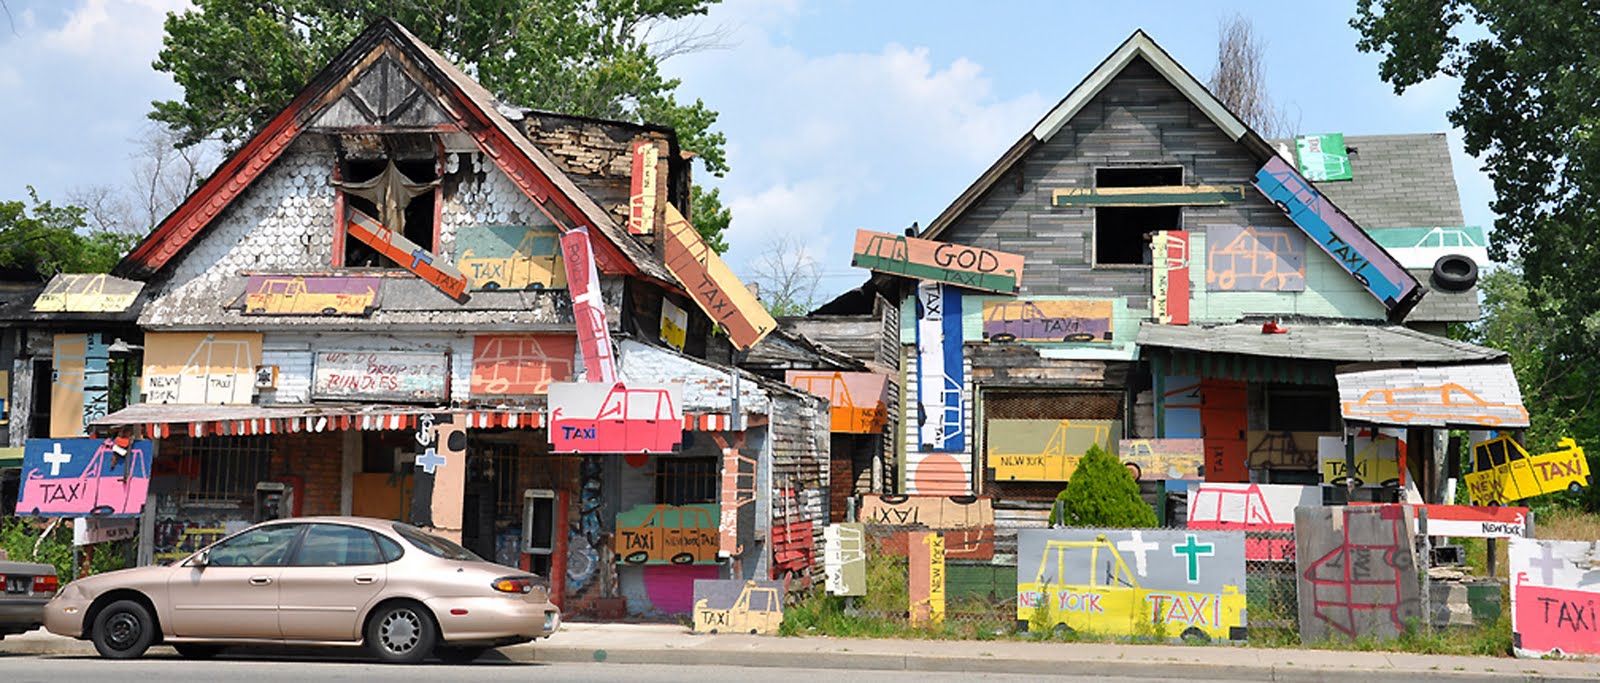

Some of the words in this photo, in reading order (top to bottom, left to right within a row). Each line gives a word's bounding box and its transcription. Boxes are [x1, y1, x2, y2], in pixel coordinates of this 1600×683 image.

[935, 243, 999, 273] GOD
[1326, 231, 1370, 273] TAXI
[942, 268, 985, 288] TAXI
[150, 376, 180, 388] NEW
[931, 567, 943, 593] NEW
